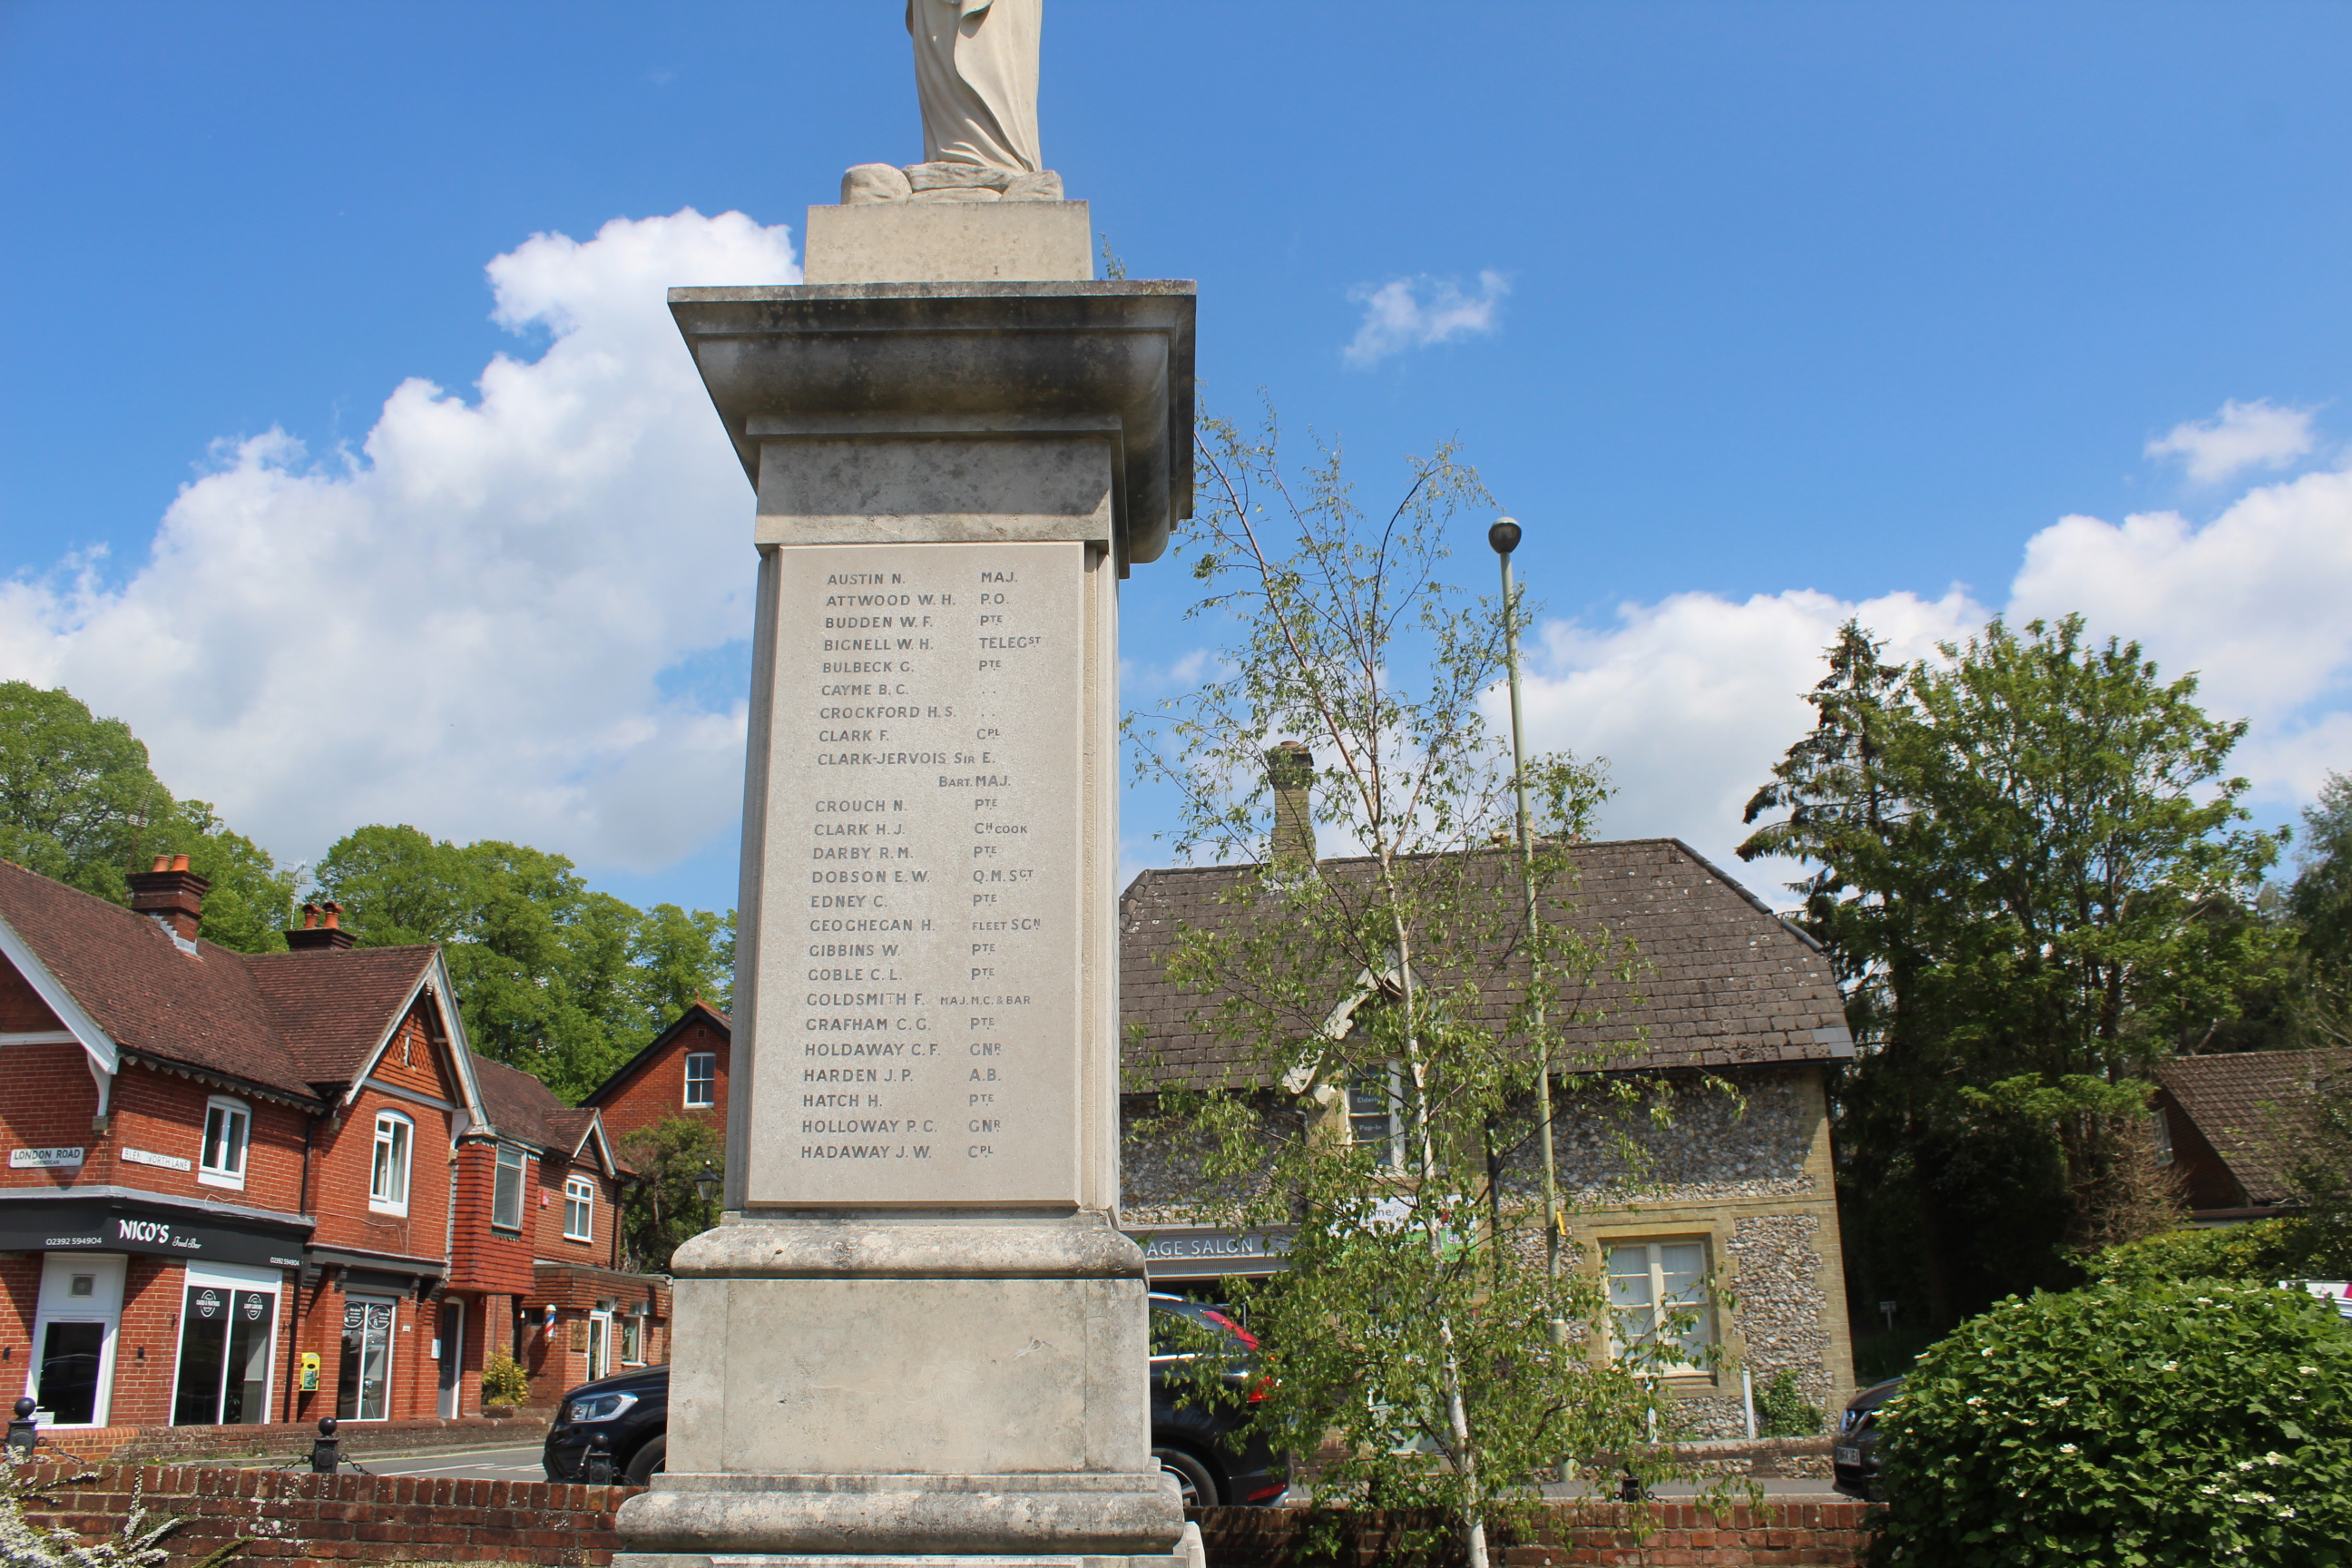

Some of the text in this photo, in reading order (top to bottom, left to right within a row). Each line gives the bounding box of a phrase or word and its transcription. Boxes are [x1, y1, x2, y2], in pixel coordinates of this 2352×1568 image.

[827, 573, 884, 585] AUSTIN
[826, 594, 911, 607] ATTWOOD
[825, 616, 893, 629] BUDDEN
[823, 638, 892, 652] BIGNELL
[822, 661, 893, 674] BULBECK
[820, 683, 872, 697] CAYME
[819, 706, 920, 720] CROCKFORD
[818, 730, 873, 742] CLARK
[817, 751, 946, 766] CLARK-JERVOIS
[954, 751, 975, 764] SIR
[815, 799, 886, 813] CROUCH
[814, 823, 869, 837] CLARK
[995, 825, 1028, 835] COOK
[812, 847, 872, 860] DARBY
[811, 870, 887, 884] DOBSON
[810, 895, 867, 908] EDNEY
[809, 918, 913, 932] GEOGHEGAN
[972, 921, 1008, 931] FLEET
[808, 944, 875, 957] GIBBINS
[808, 968, 863, 982] GOBLE
[806, 993, 906, 1006] GOLDSMITH
[1005, 995, 1031, 1005] BAR
[805, 1017, 888, 1032] GRAFHAM
[805, 1043, 905, 1057] HOLDAWAY
[803, 1068, 877, 1083] HARDEN
[802, 1093, 859, 1108] HATCH
[801, 1119, 900, 1133] HOLLOWAY
[14, 1149, 81, 1160] LONDON ROAD
[800, 1145, 890, 1160] HADAWAY
[119, 1219, 170, 1244] NICO'S
[46, 1237, 102, 1246] 02392 594904
[1191, 1238, 1253, 1254] SALON
